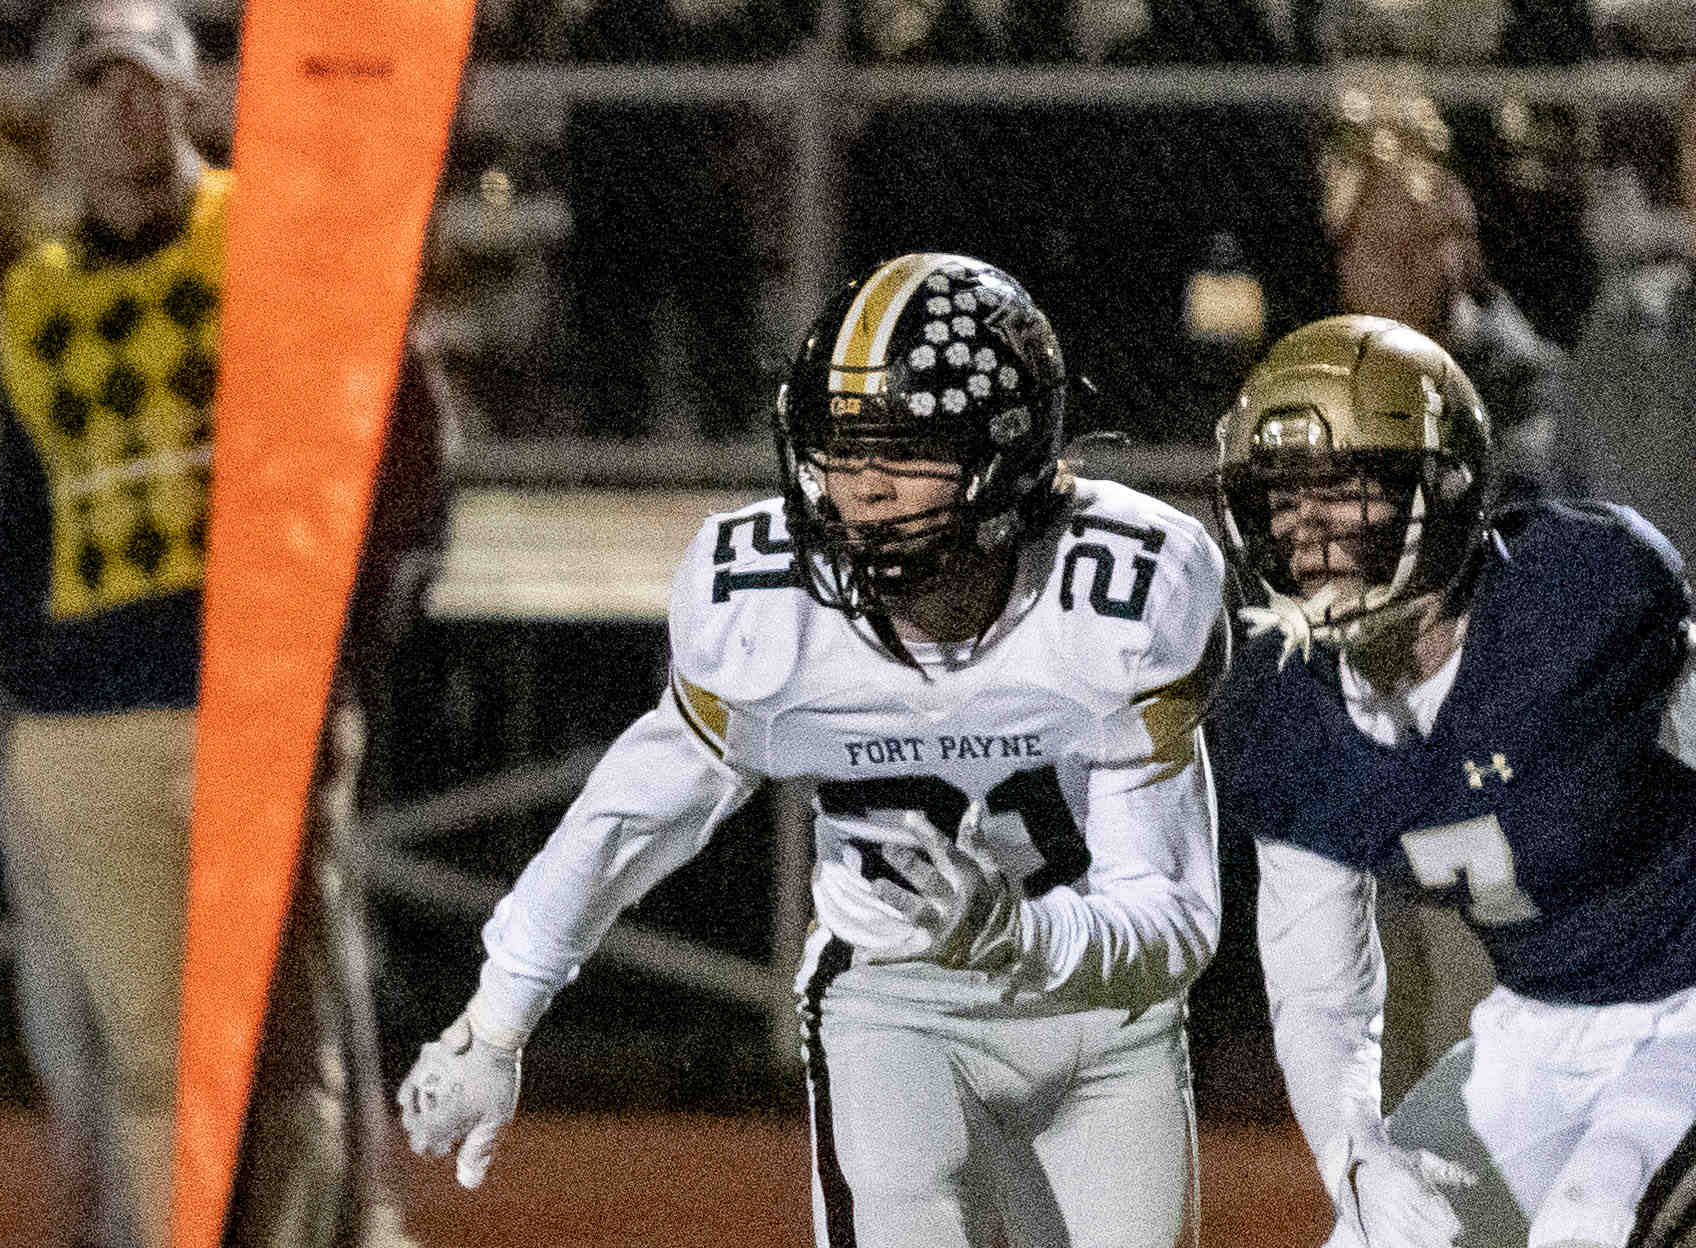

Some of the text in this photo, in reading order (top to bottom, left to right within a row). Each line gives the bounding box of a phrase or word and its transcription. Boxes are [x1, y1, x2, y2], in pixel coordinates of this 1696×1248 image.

[712, 511, 806, 604] 21
[1060, 514, 1166, 621] 21
[844, 734, 1042, 767] FORT PAYNE
[1400, 813, 1542, 928] 7
